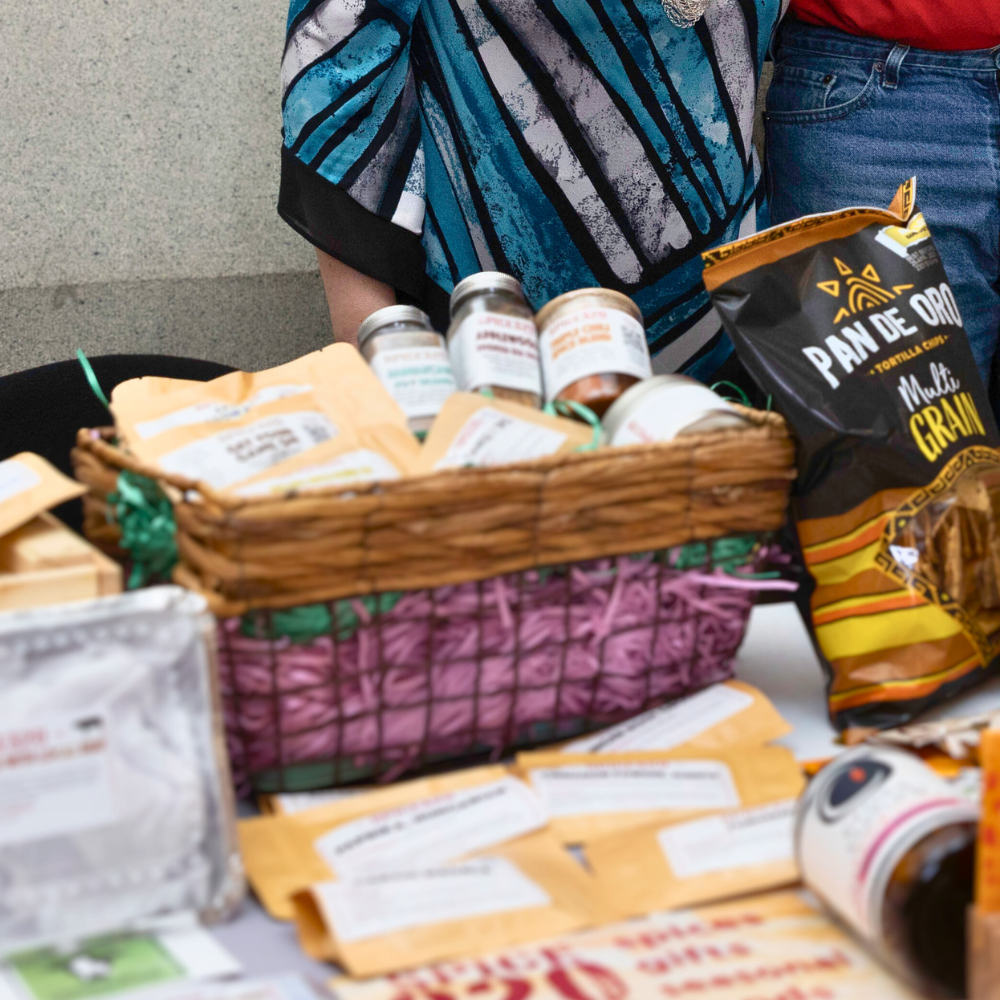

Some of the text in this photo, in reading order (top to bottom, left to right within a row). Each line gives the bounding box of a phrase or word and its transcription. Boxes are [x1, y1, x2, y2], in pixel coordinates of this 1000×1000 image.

[802, 282, 963, 390] PAN DE ORO
[874, 335, 945, 374] TORTILLA CHIPS
[898, 362, 960, 412] Multi
[909, 392, 986, 462] GRAIN
